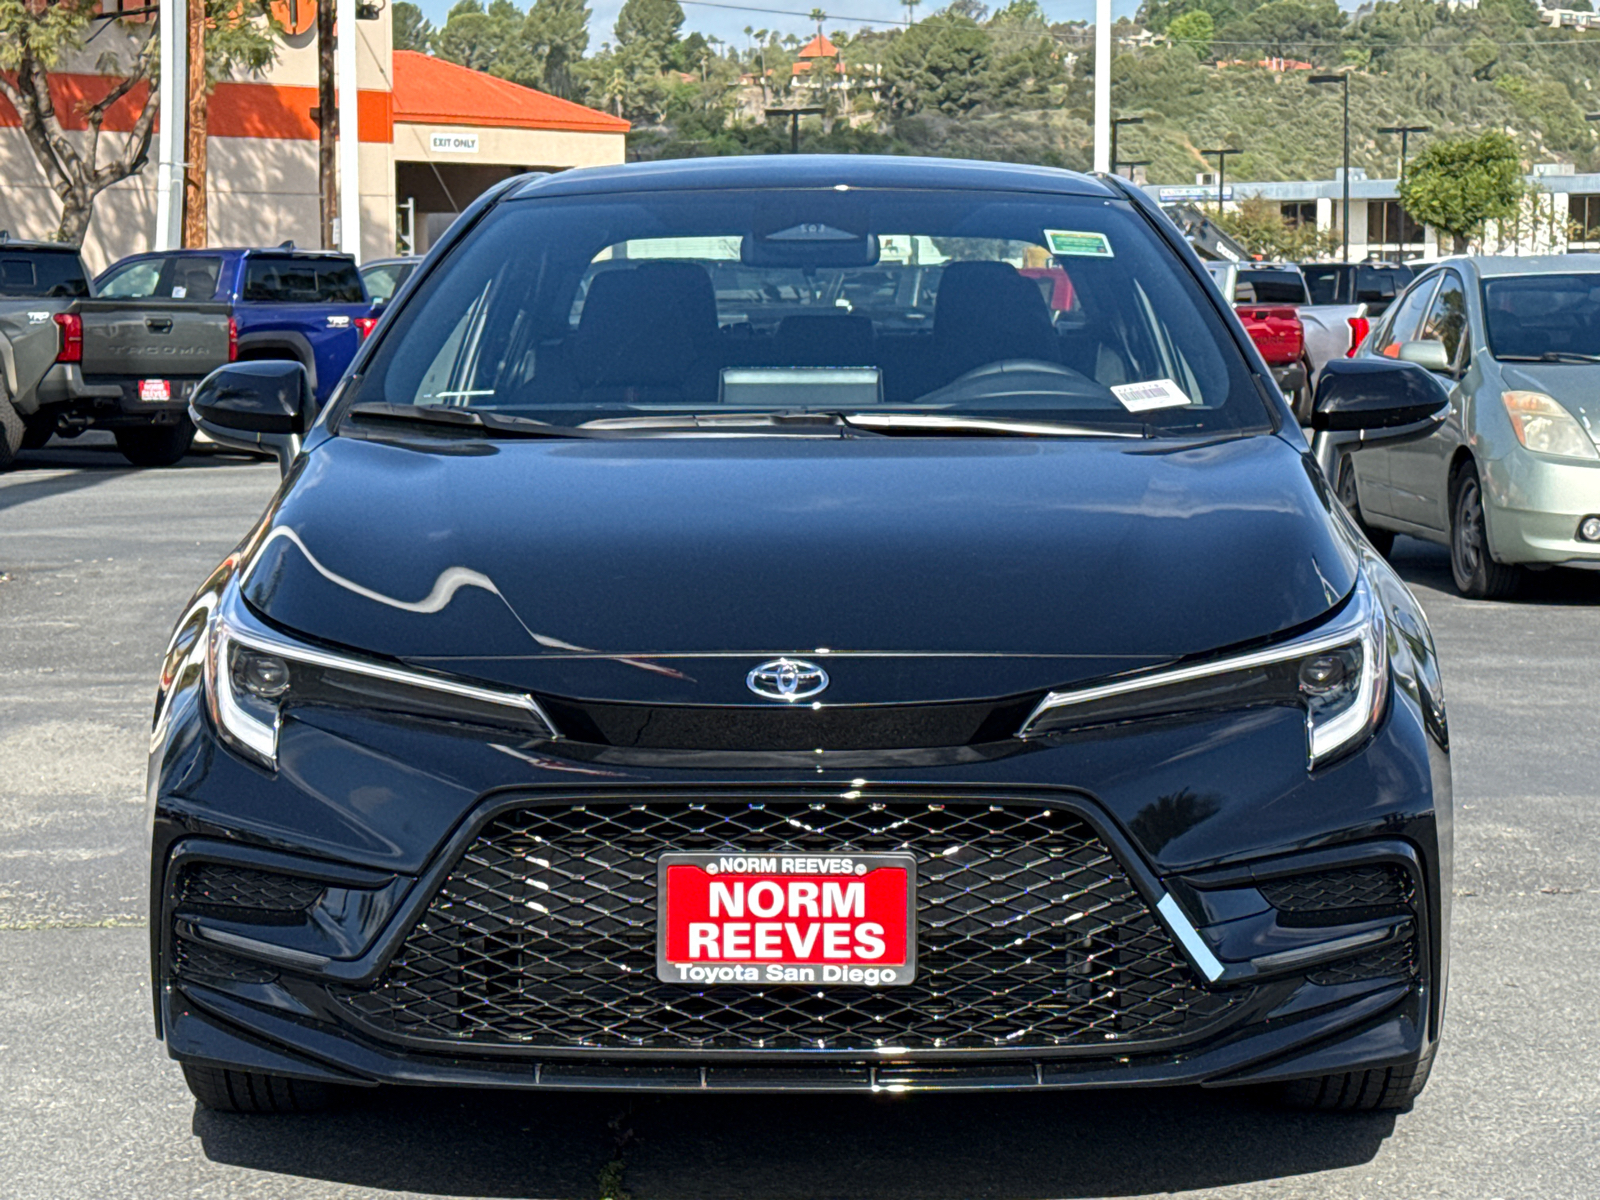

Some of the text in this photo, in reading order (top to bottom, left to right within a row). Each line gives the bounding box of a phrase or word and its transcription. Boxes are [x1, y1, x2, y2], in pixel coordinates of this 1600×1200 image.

[433, 137, 476, 148] EXIT ONLY
[109, 345, 210, 355] TACOMA
[719, 857, 854, 874] NORM REEVES
[708, 881, 865, 918] NORM
[688, 922, 886, 960] REEVES
[675, 963, 897, 986] Toyota San Diego
